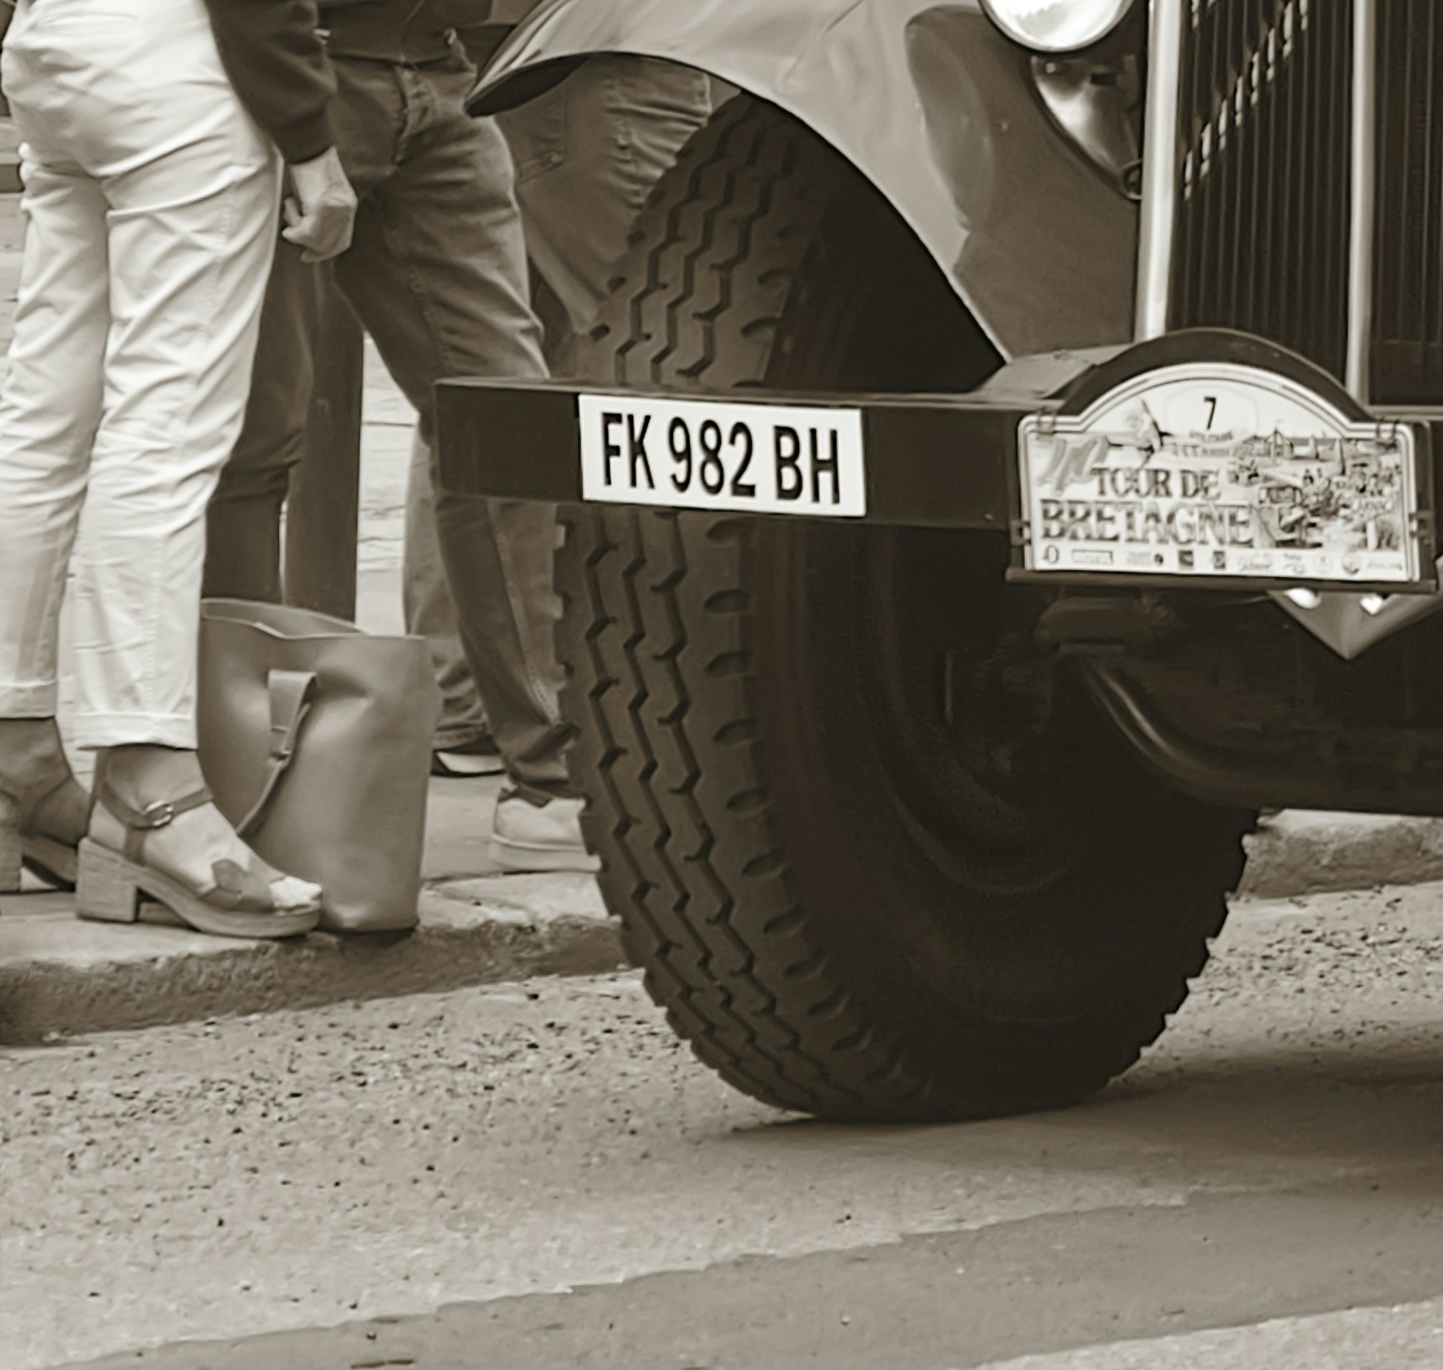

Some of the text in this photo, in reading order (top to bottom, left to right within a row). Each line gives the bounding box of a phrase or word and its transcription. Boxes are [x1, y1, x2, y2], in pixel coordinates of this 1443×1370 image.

[1203, 396, 1218, 430] 7
[601, 411, 841, 505] FK 982 BH
[1090, 467, 1221, 499] TOUR DE
[1039, 498, 1253, 548] BRETAGNE
